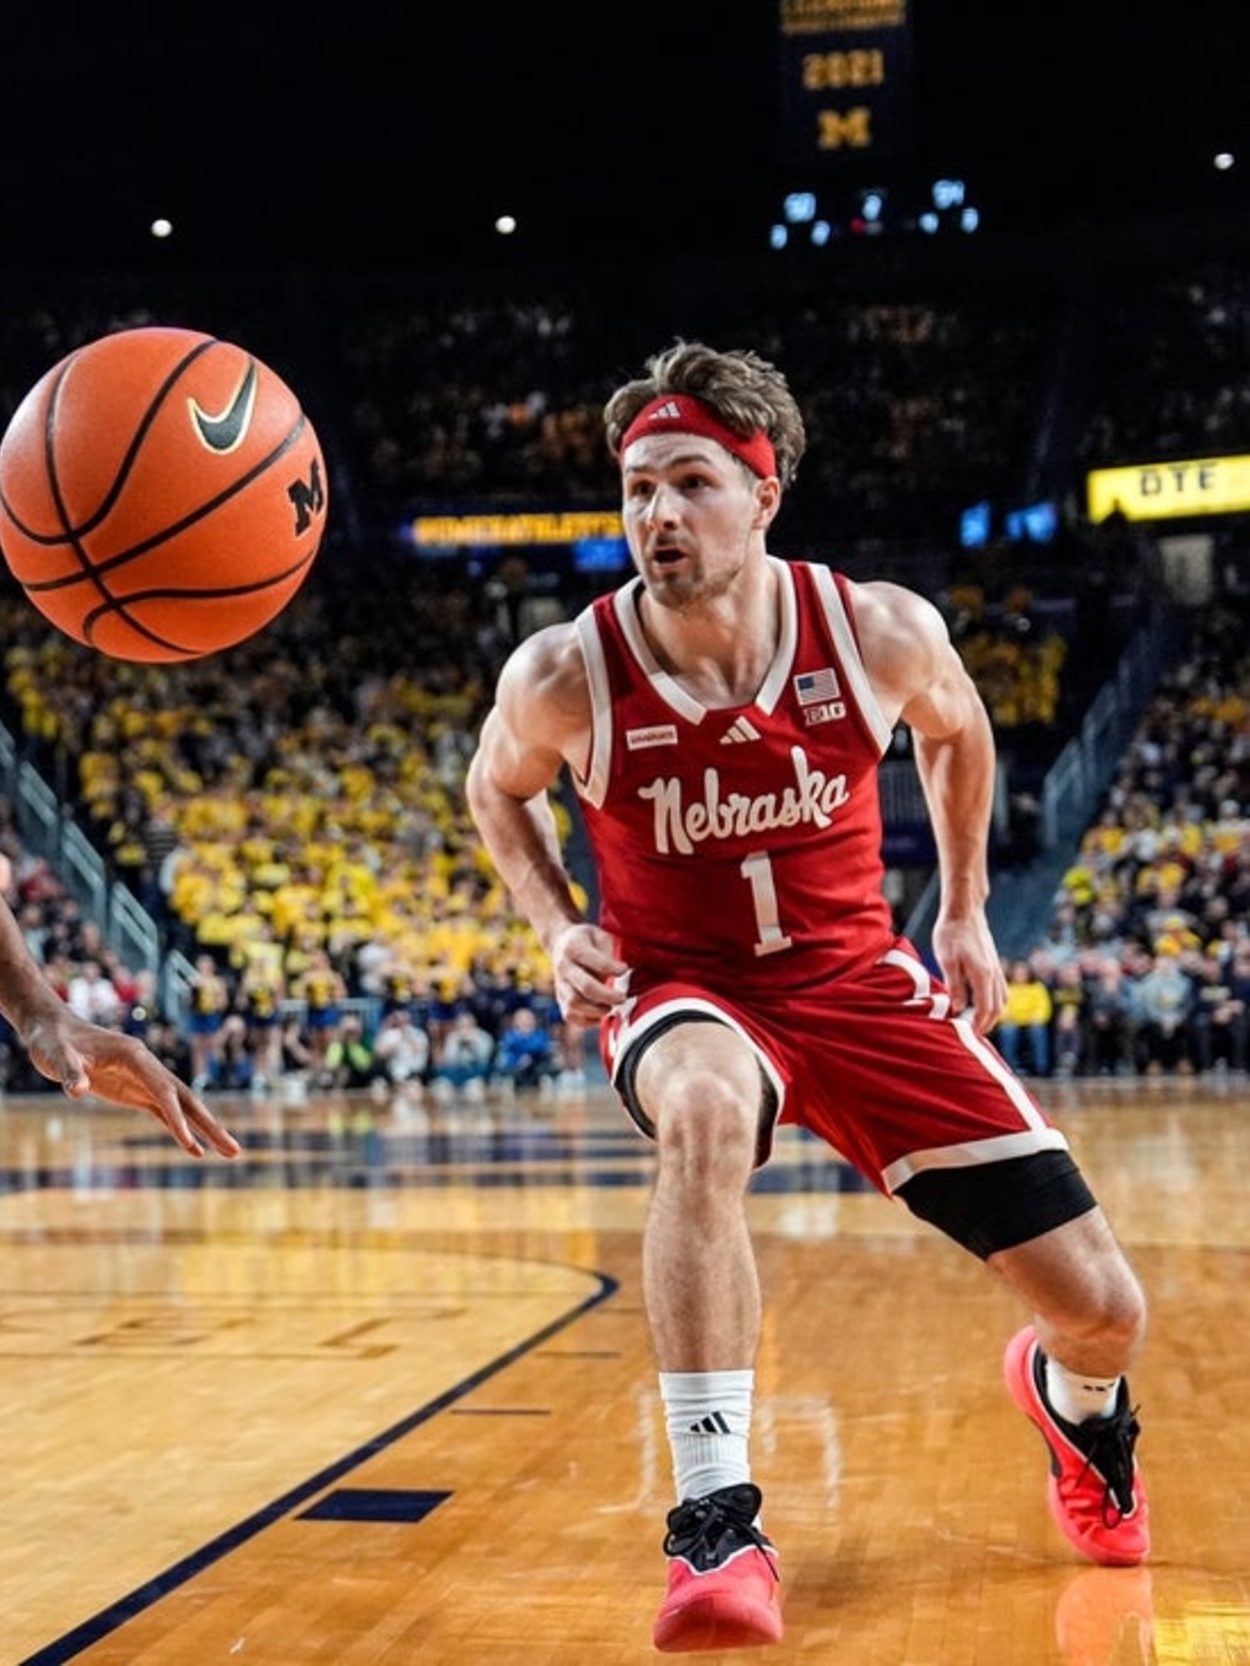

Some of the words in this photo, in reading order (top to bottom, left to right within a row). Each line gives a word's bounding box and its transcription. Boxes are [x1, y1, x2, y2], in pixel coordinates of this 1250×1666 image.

[287, 455, 325, 538] M
[638, 745, 849, 855] Nebraska
[740, 851, 792, 957] 1
